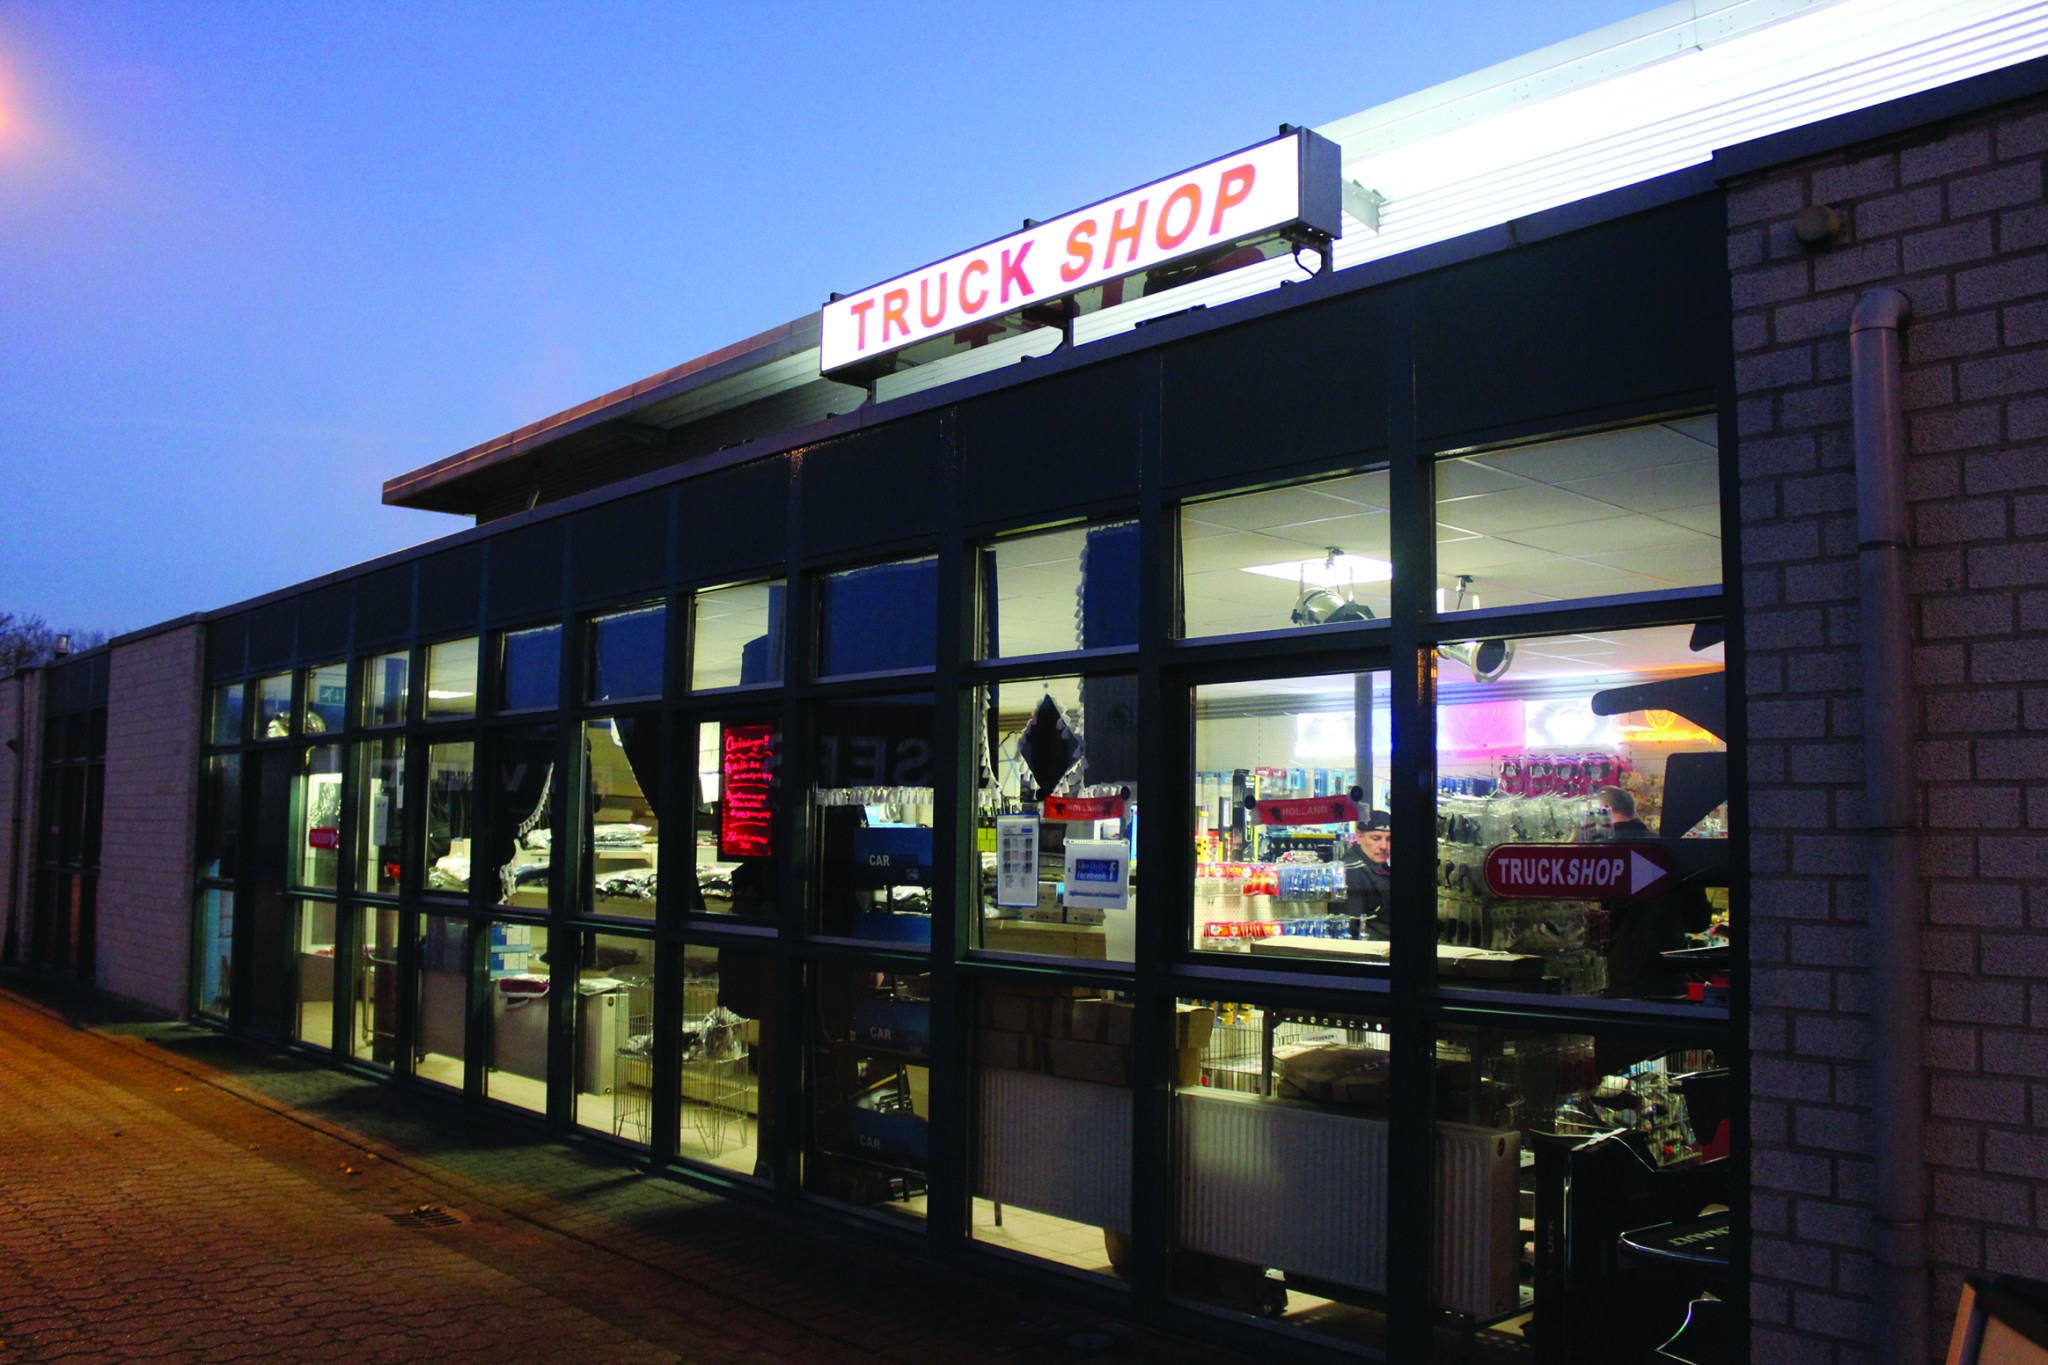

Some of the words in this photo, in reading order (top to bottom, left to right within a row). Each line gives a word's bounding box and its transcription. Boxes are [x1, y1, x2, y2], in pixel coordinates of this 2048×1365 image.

[850, 239, 1035, 351] TRUCK
[1060, 163, 1257, 283] SHOP
[1281, 805, 1328, 816] HOLLAND
[868, 853, 891, 867] CAR
[870, 1026, 892, 1041] CAR
[859, 1133, 881, 1150] CAR
